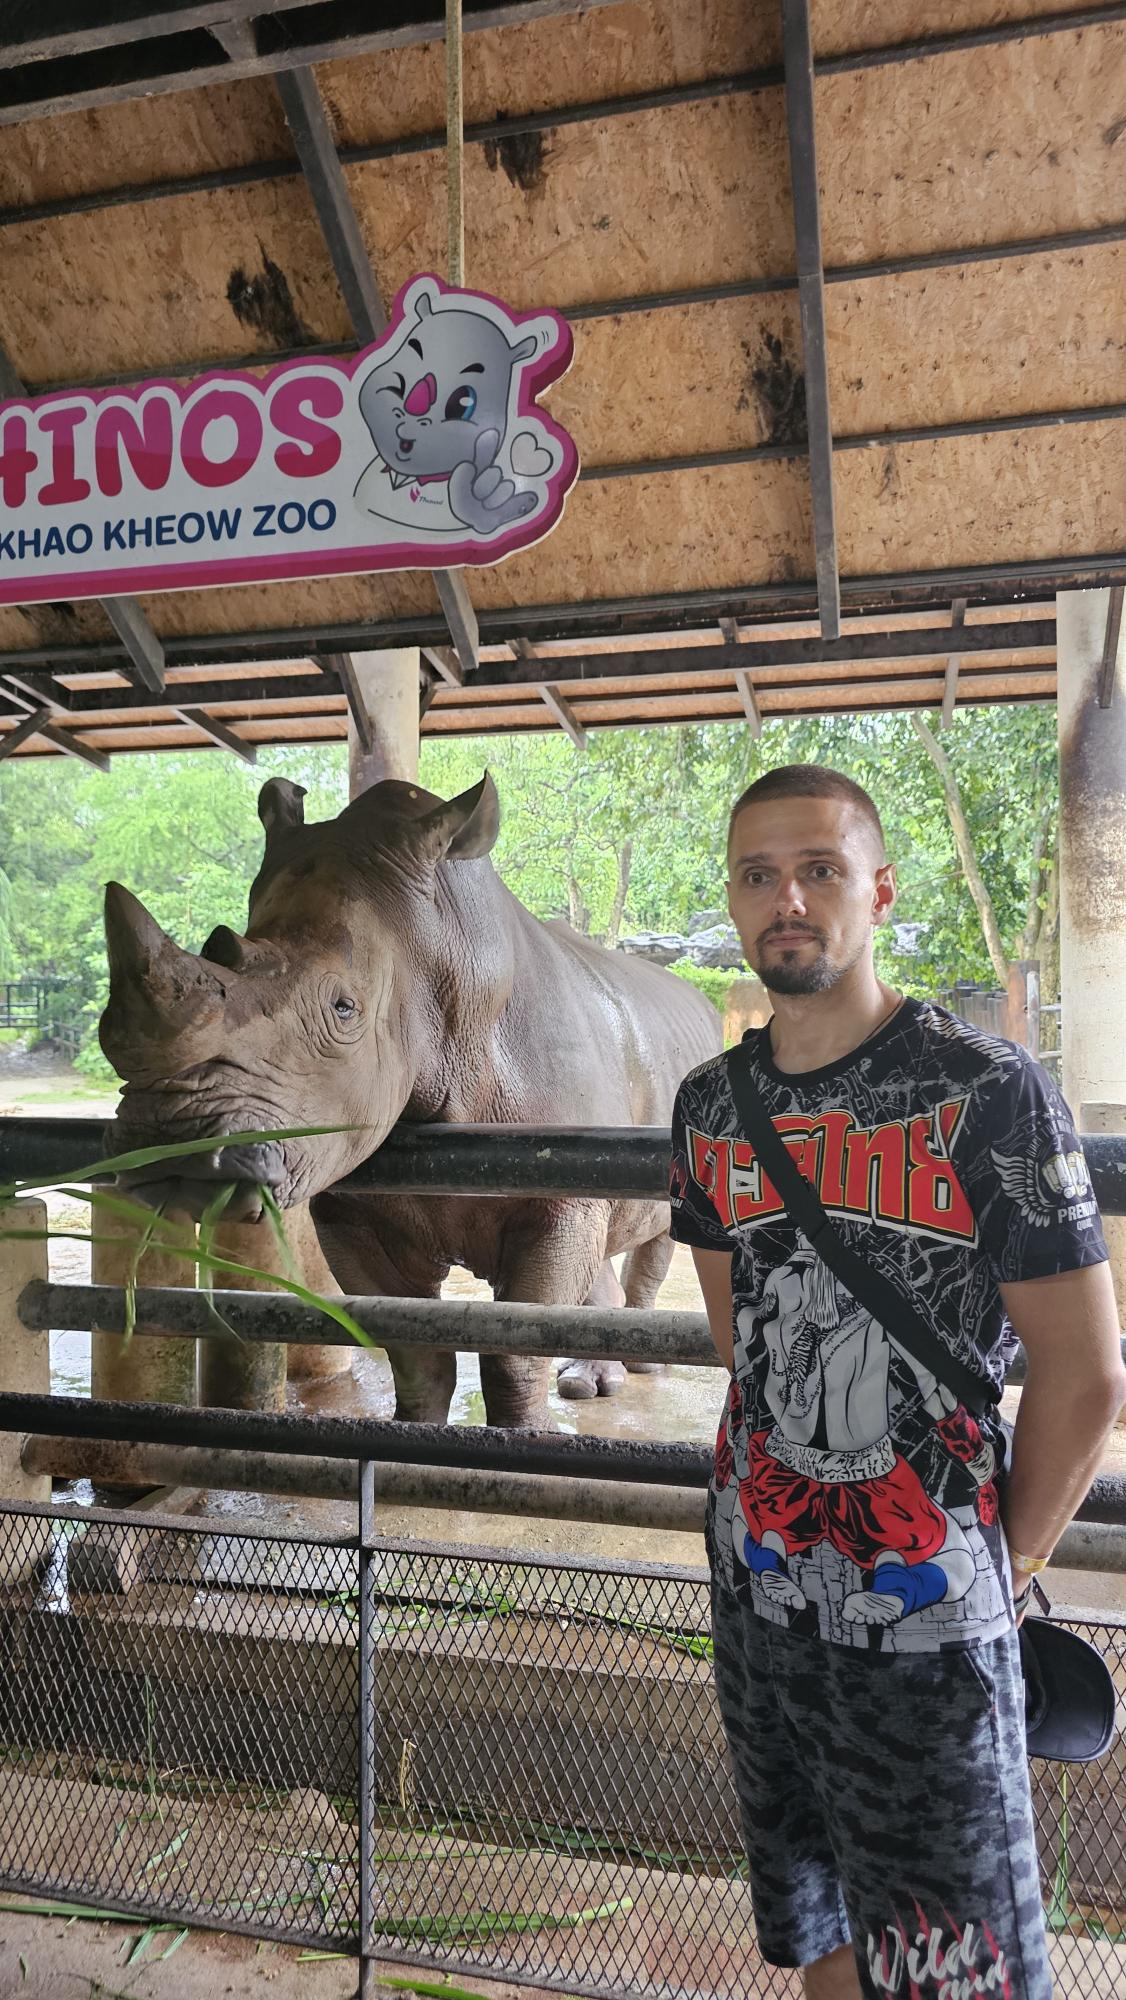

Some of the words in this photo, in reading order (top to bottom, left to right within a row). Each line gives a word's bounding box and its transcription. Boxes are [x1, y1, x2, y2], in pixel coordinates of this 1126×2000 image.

[0, 523, 93, 560] KHAO
[103, 508, 242, 550] KHEOW
[253, 499, 337, 536] ZOO
[915, 1010, 977, 1040] MUAY
[963, 1035, 1020, 1064] THAI
[867, 1922, 982, 1992] Wild
